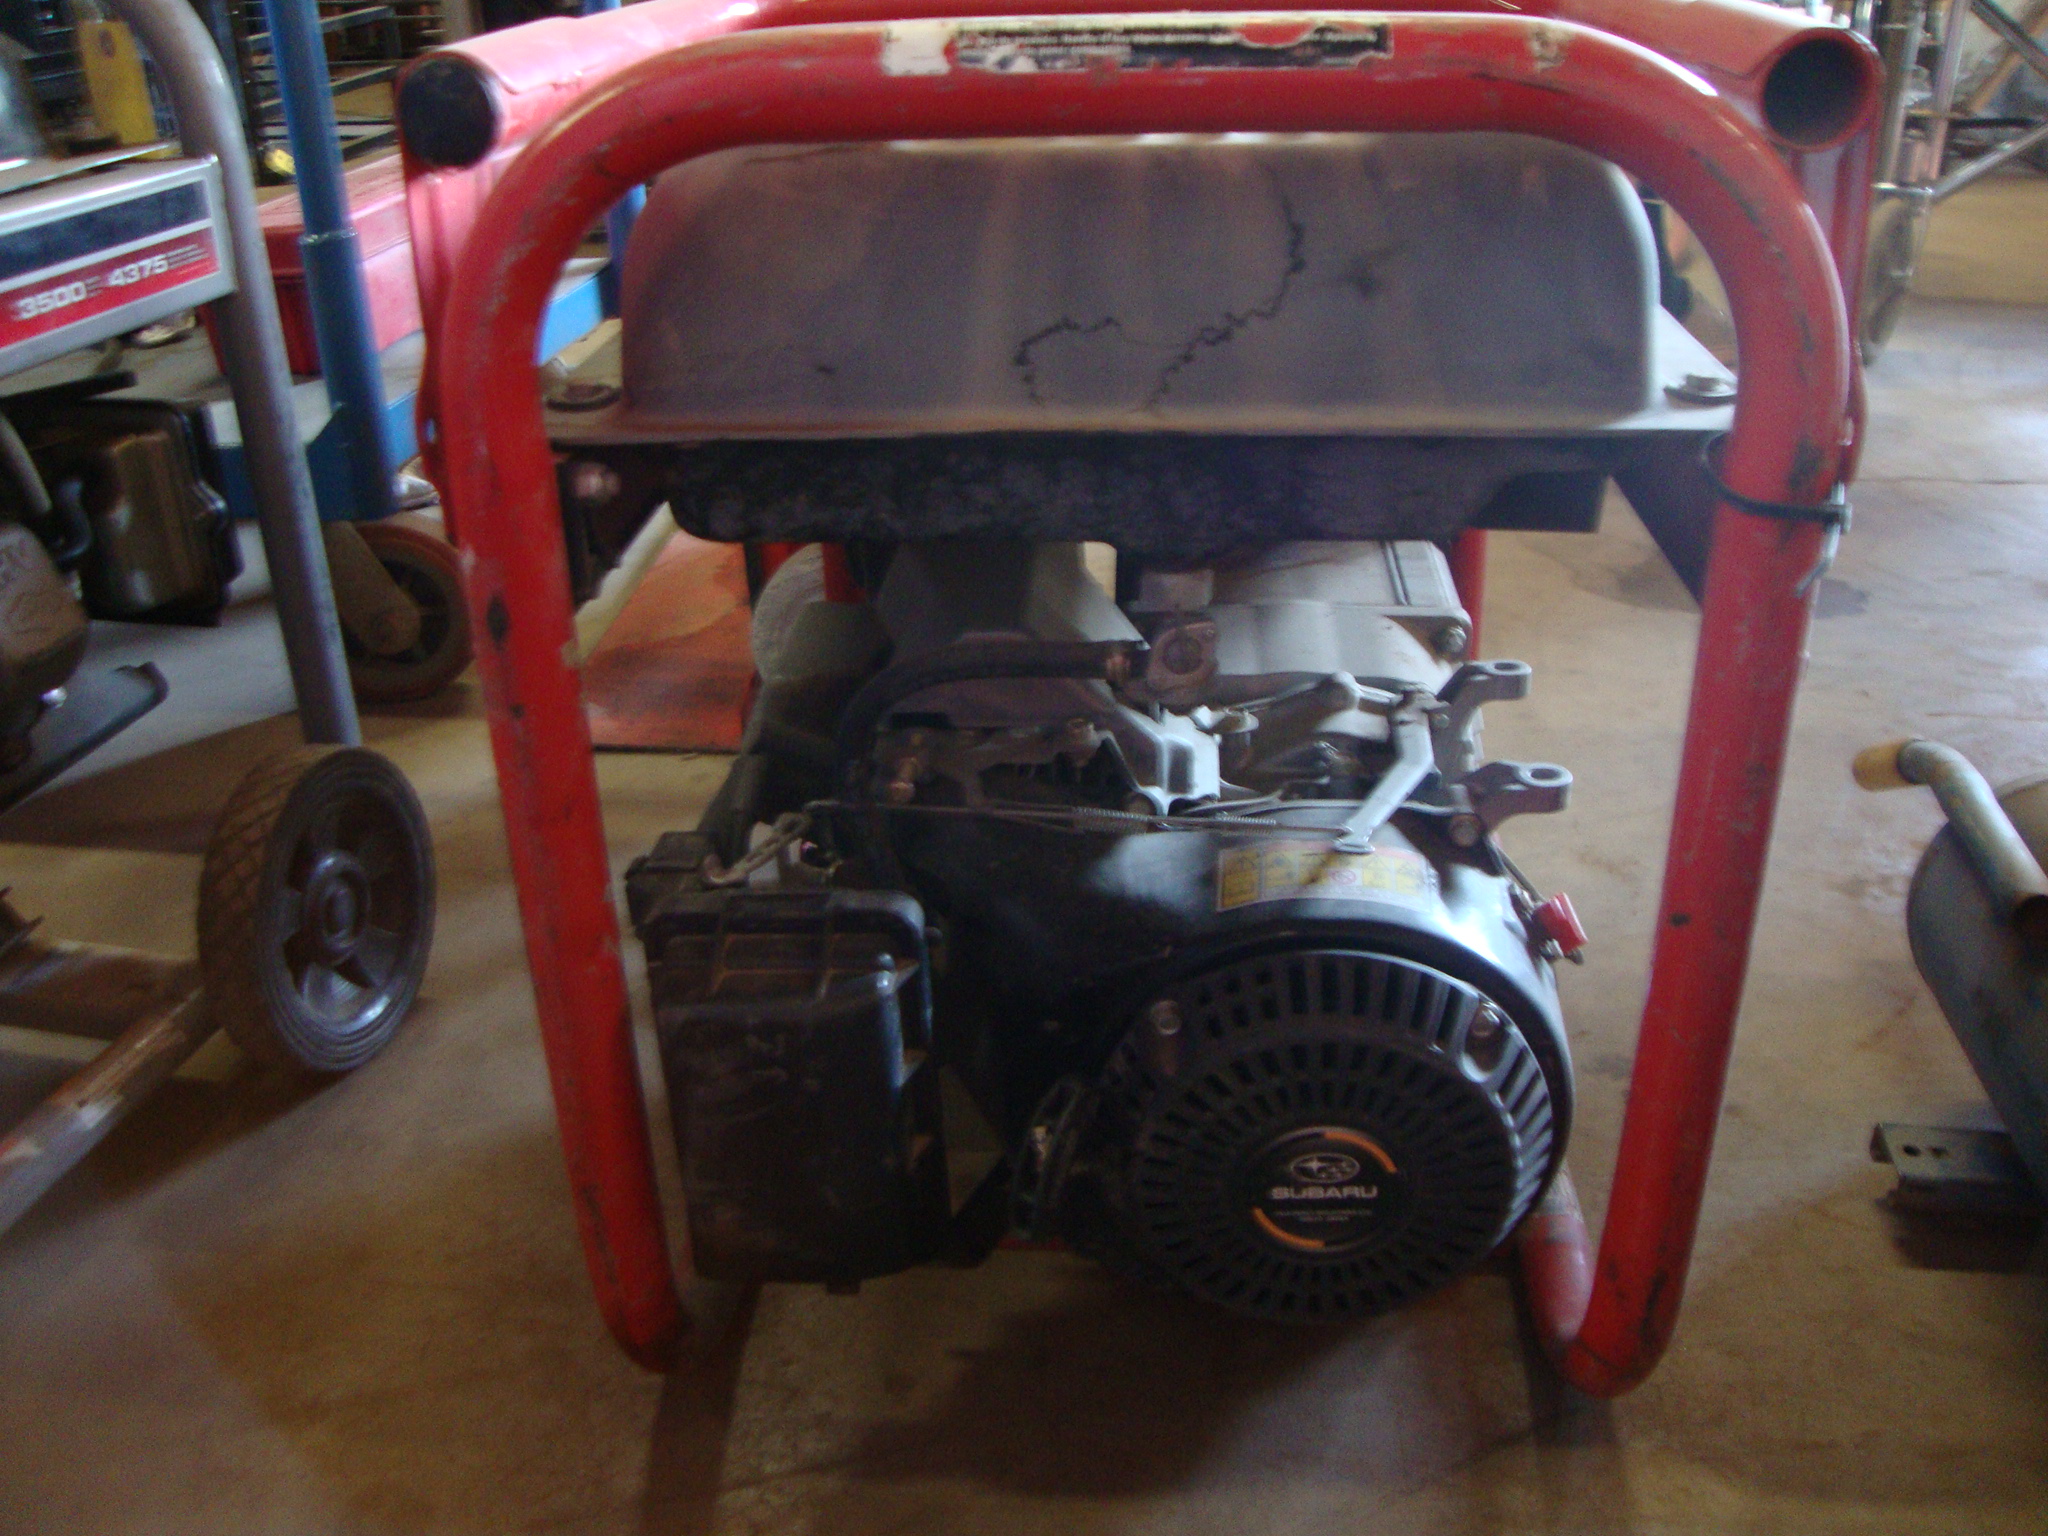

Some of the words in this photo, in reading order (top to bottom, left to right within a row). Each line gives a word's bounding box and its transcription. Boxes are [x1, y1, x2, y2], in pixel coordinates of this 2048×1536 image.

[17, 281, 87, 320] 3500
[108, 253, 169, 287] 4375
[1271, 1186, 1379, 1200] SUBARU
